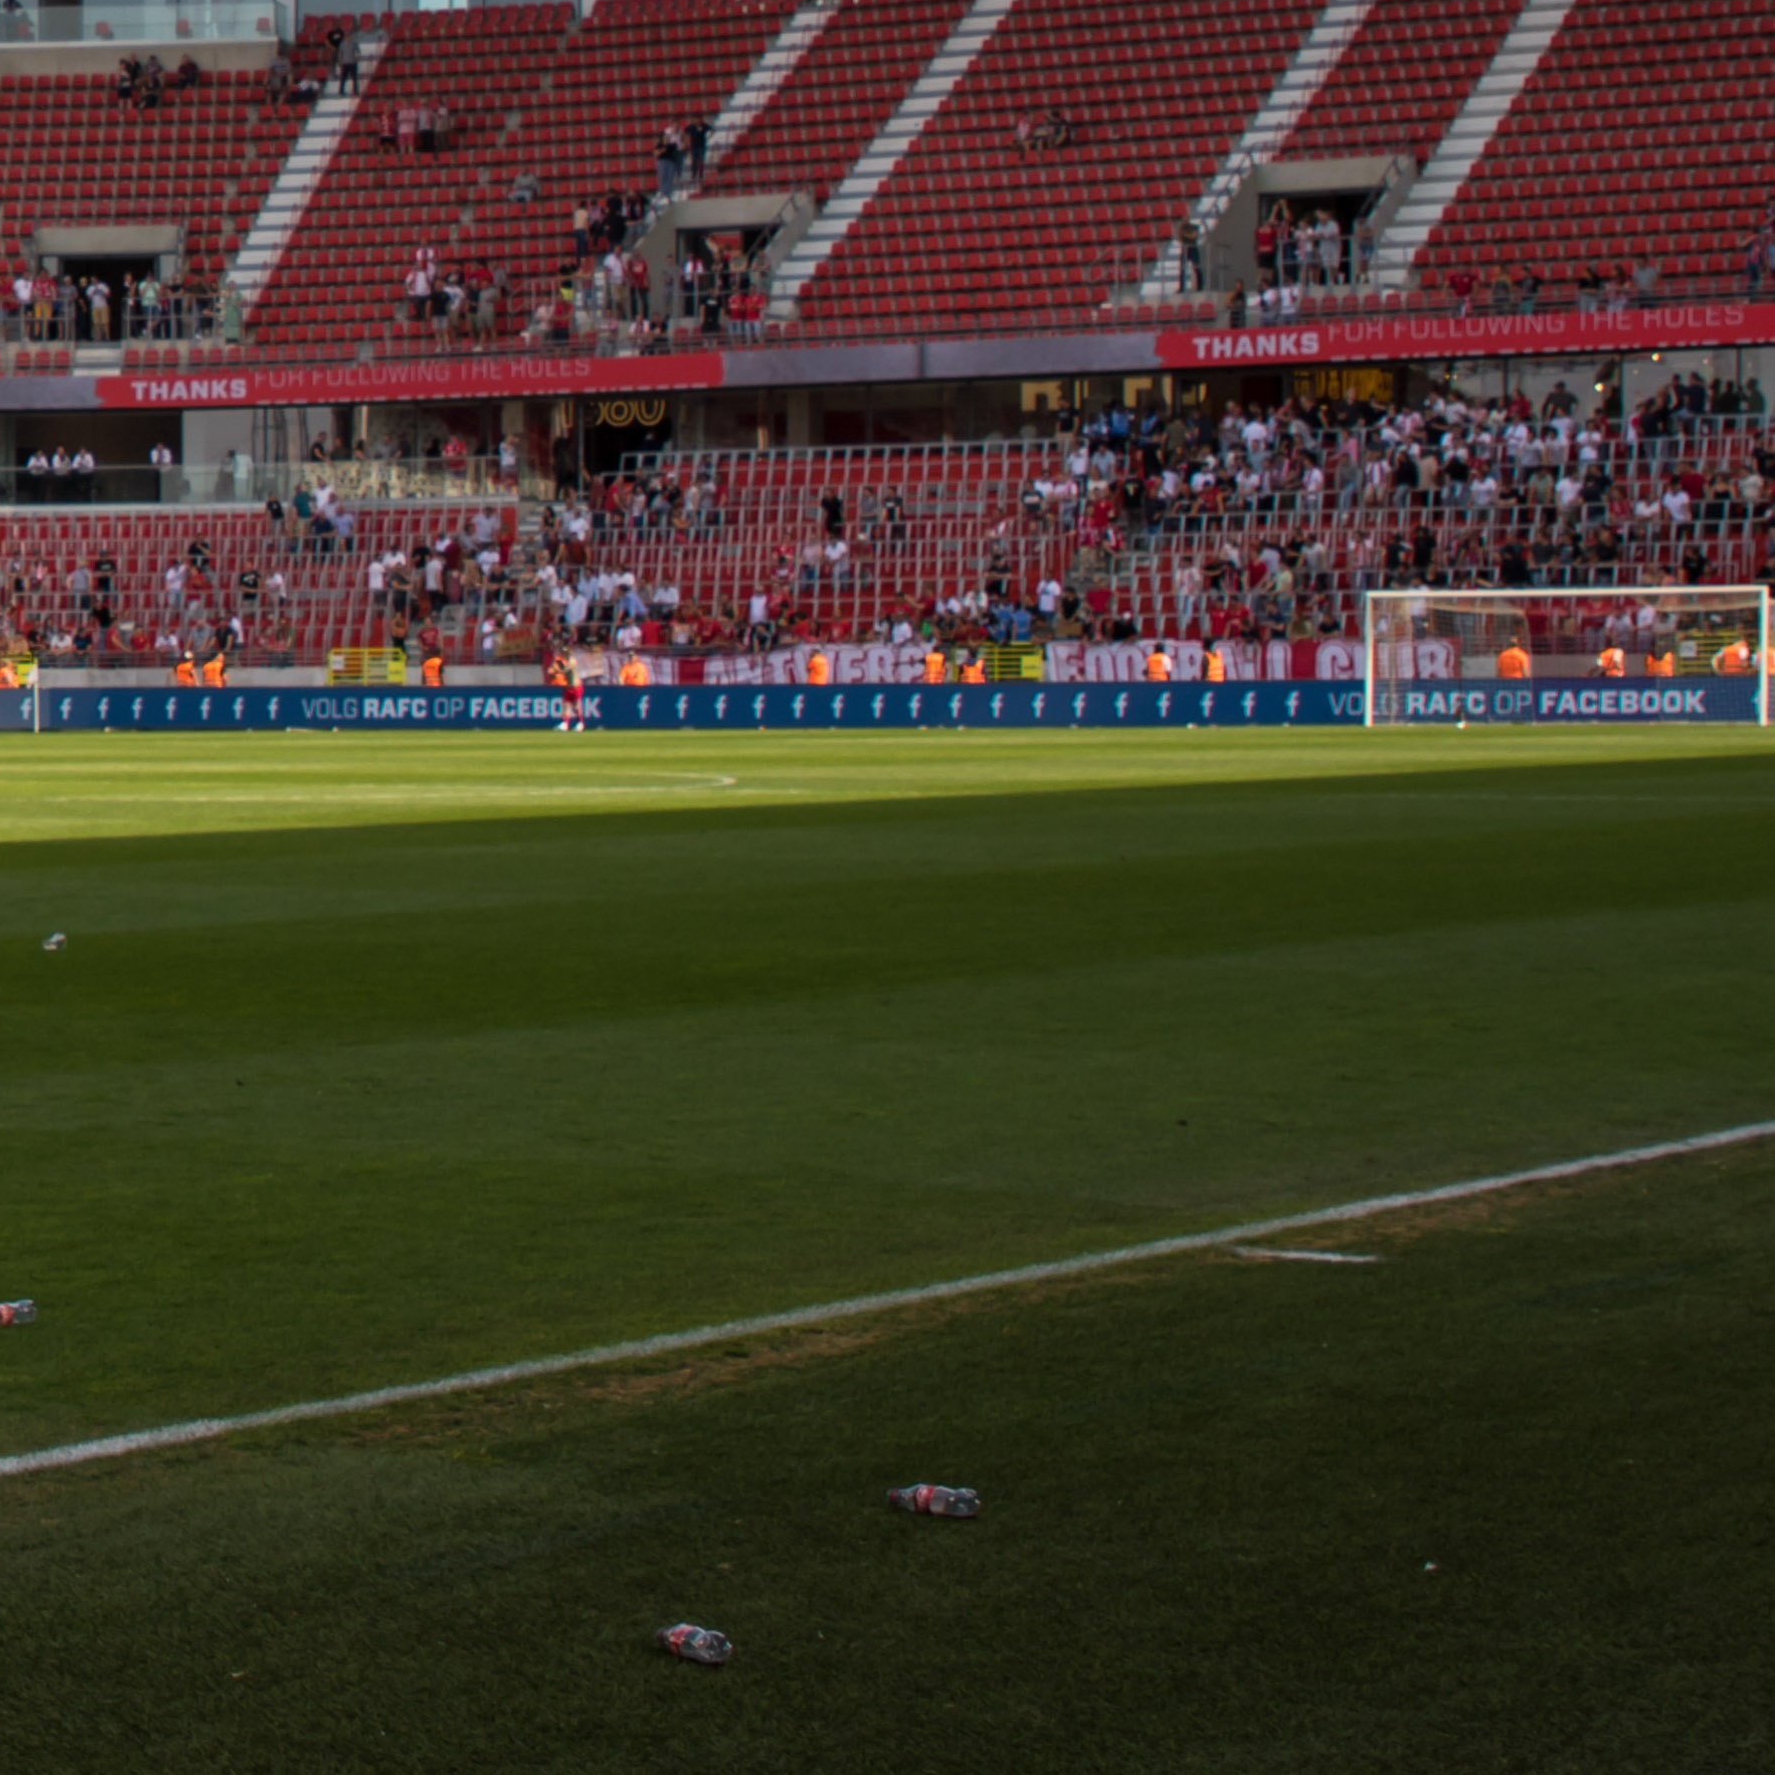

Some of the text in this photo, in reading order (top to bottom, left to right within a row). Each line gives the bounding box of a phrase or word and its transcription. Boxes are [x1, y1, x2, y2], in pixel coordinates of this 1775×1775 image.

[1193, 332, 1318, 359] THANKS
[131, 378, 247, 402] THANKS
[302, 697, 601, 719] VOLG RAFC OP FACEBOK
[1406, 691, 1486, 714] RAFC
[1494, 690, 1533, 713] OP
[1540, 689, 1706, 714] FACEBOOK
